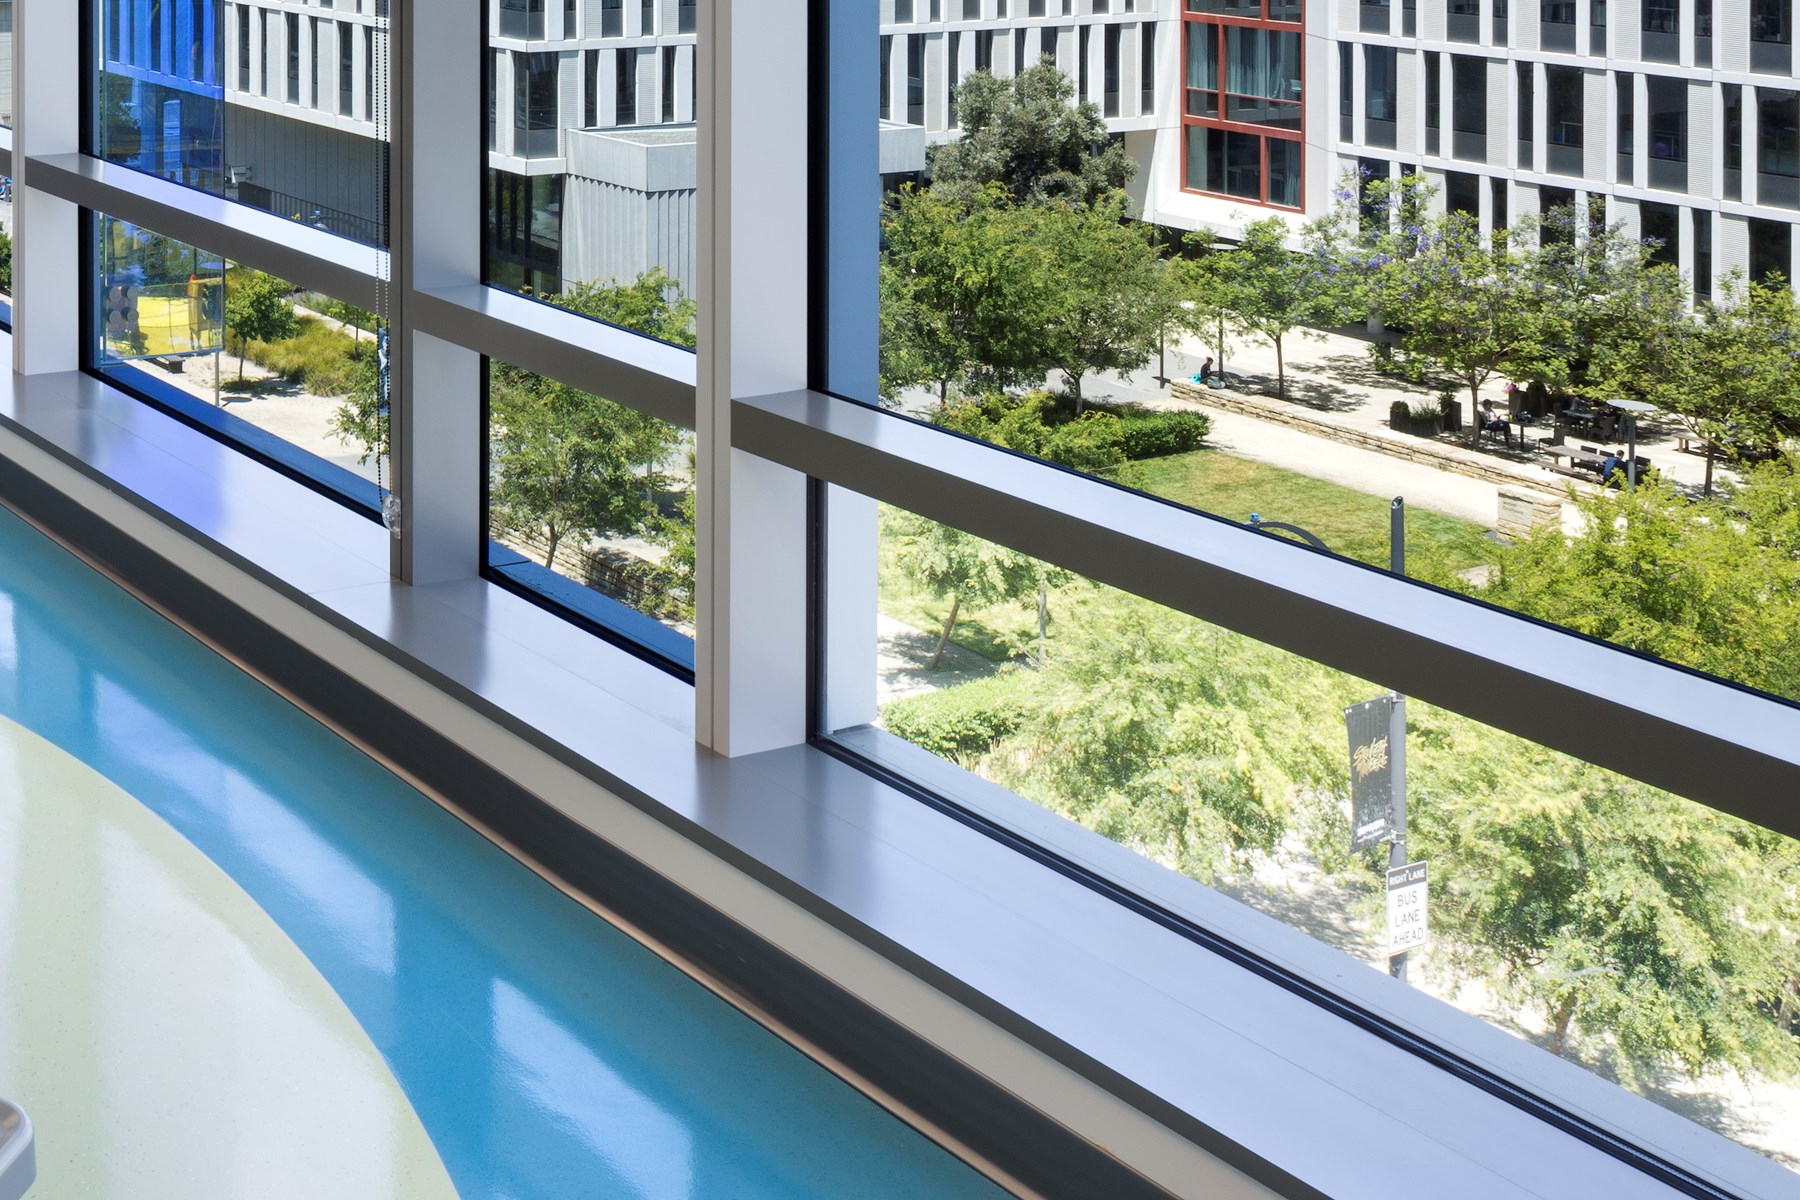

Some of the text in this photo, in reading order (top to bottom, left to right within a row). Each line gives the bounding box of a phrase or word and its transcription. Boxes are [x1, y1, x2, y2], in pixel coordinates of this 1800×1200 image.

[1389, 868, 1426, 887] RIGHT LANE
[1397, 890, 1417, 907] BUS
[1395, 909, 1420, 928] LANE
[1393, 927, 1423, 948] AHEAD
